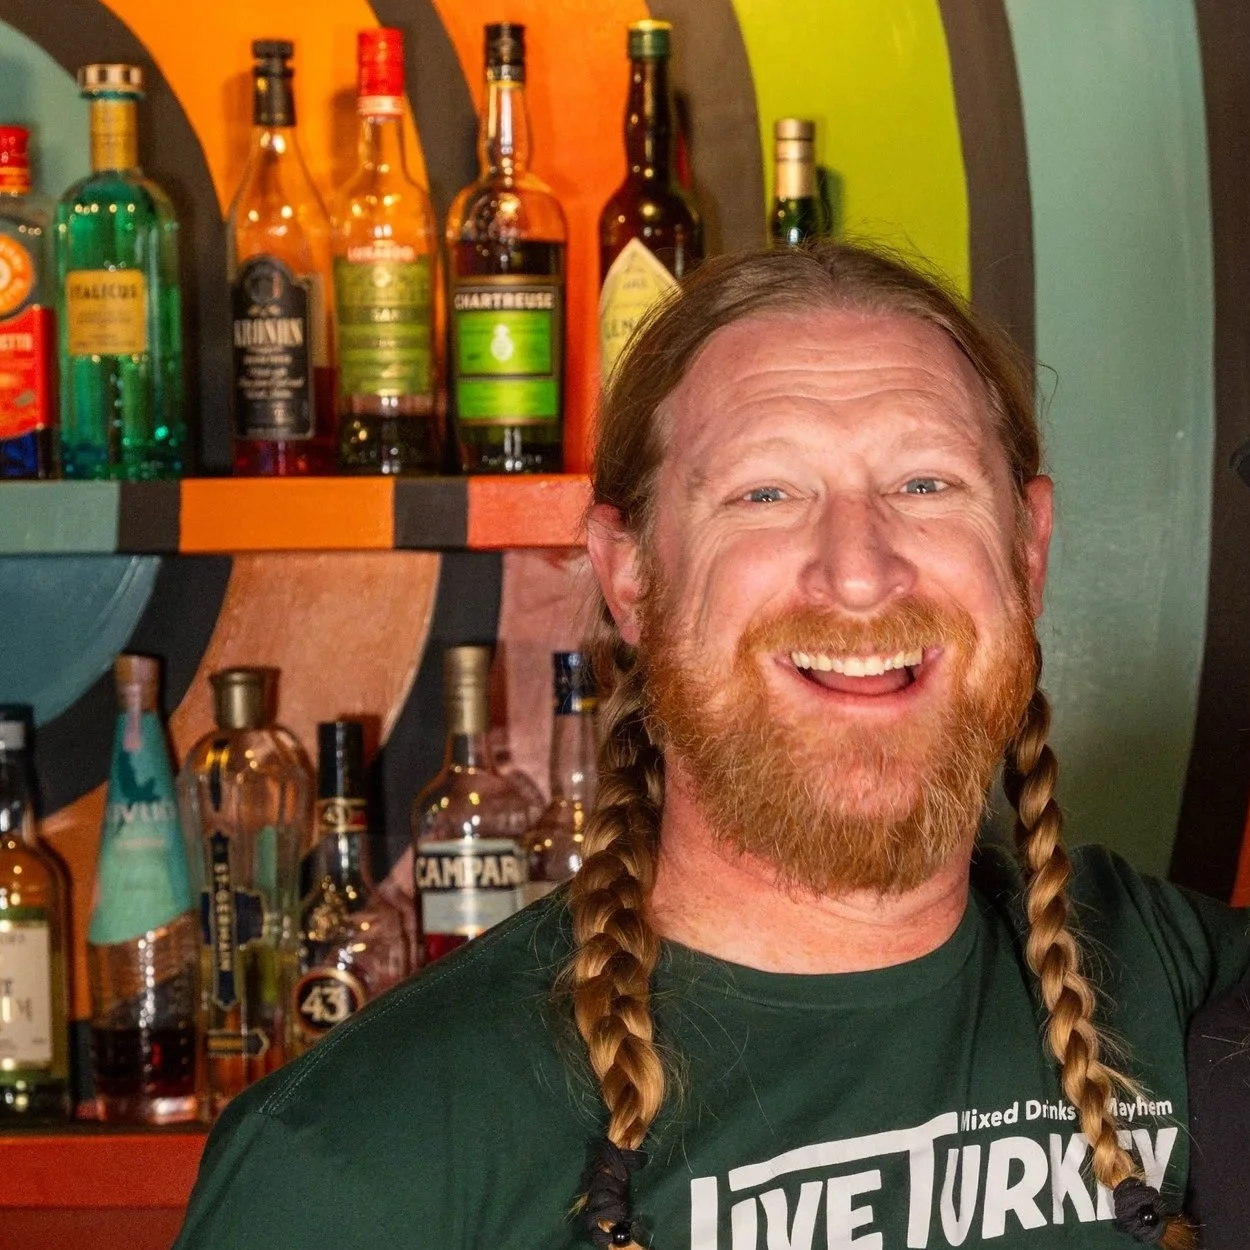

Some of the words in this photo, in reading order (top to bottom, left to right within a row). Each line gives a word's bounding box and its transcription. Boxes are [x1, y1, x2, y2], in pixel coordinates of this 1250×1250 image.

[454, 292, 555, 310] CHARTREUSE
[301, 985, 350, 1023] 43
[961, 1101, 1019, 1132] Mixed
[1025, 1099, 1077, 1121] Drinks
